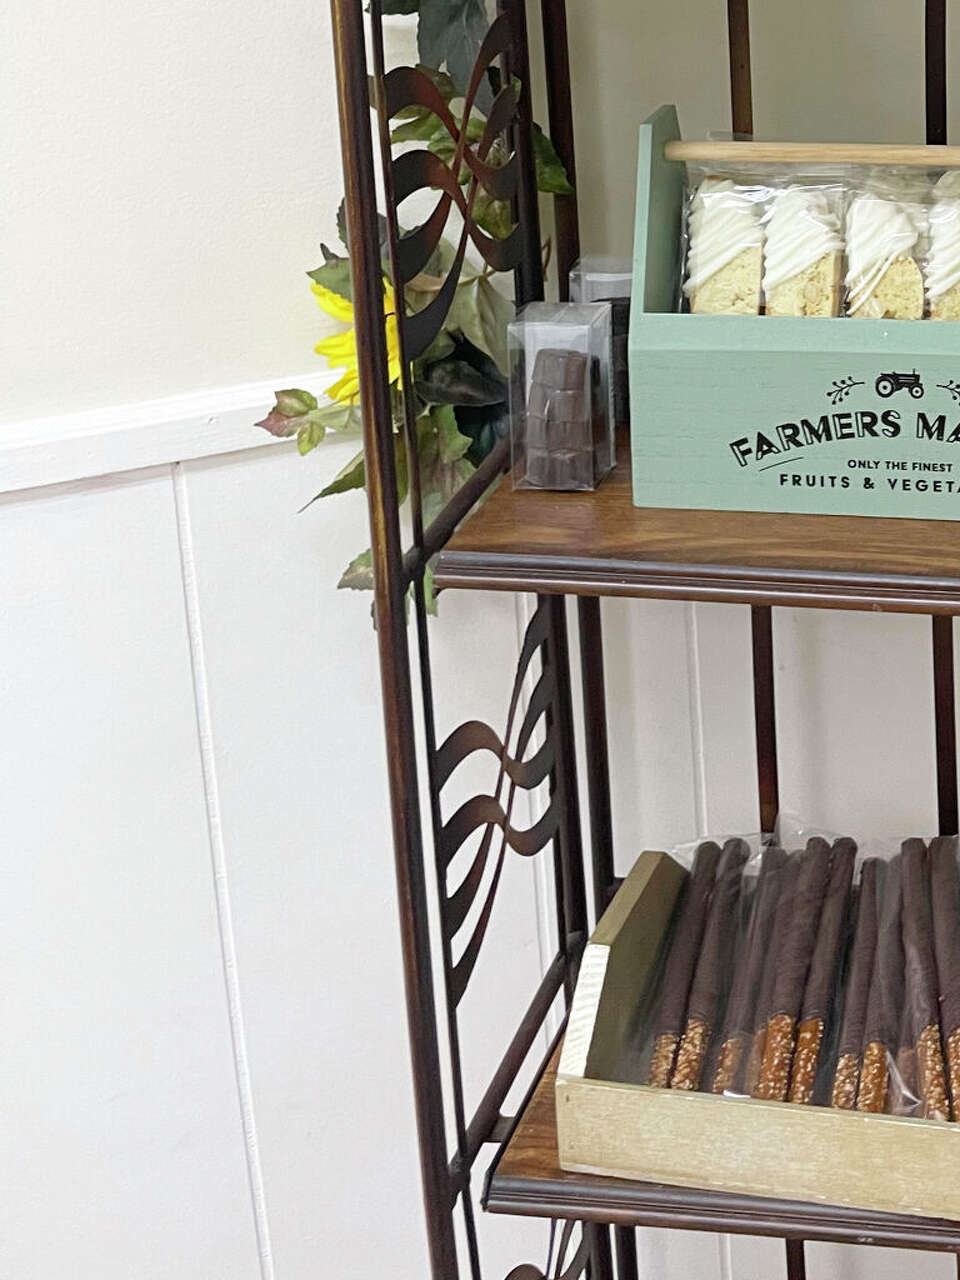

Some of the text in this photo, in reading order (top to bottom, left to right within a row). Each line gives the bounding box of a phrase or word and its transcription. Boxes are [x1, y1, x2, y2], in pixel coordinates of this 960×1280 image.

[729, 409, 902, 468] FARMERS
[847, 458, 954, 473] ONLY THE FINEST
[779, 473, 851, 490] FRUITS
[863, 477, 876, 491] &
